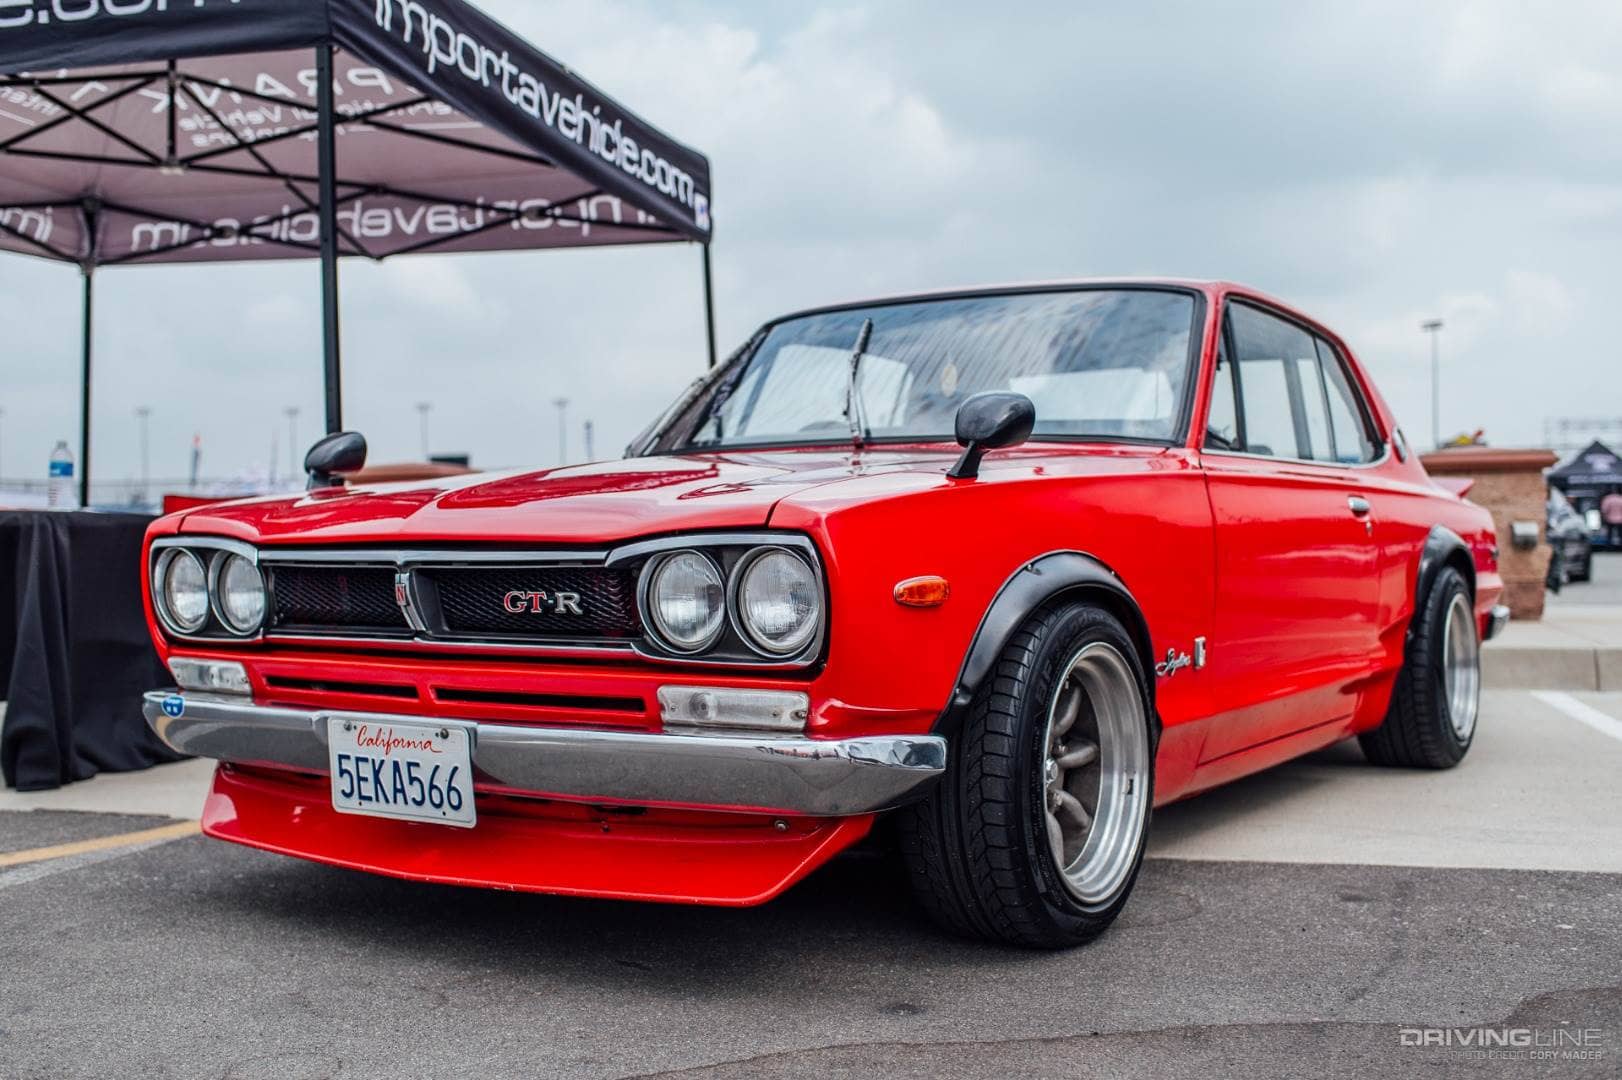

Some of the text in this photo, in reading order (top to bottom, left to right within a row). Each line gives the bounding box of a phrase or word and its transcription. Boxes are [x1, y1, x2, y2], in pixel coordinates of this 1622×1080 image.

[503, 591, 583, 615] GT-R
[357, 725, 443, 755] California
[338, 753, 463, 811] 5EKA566
